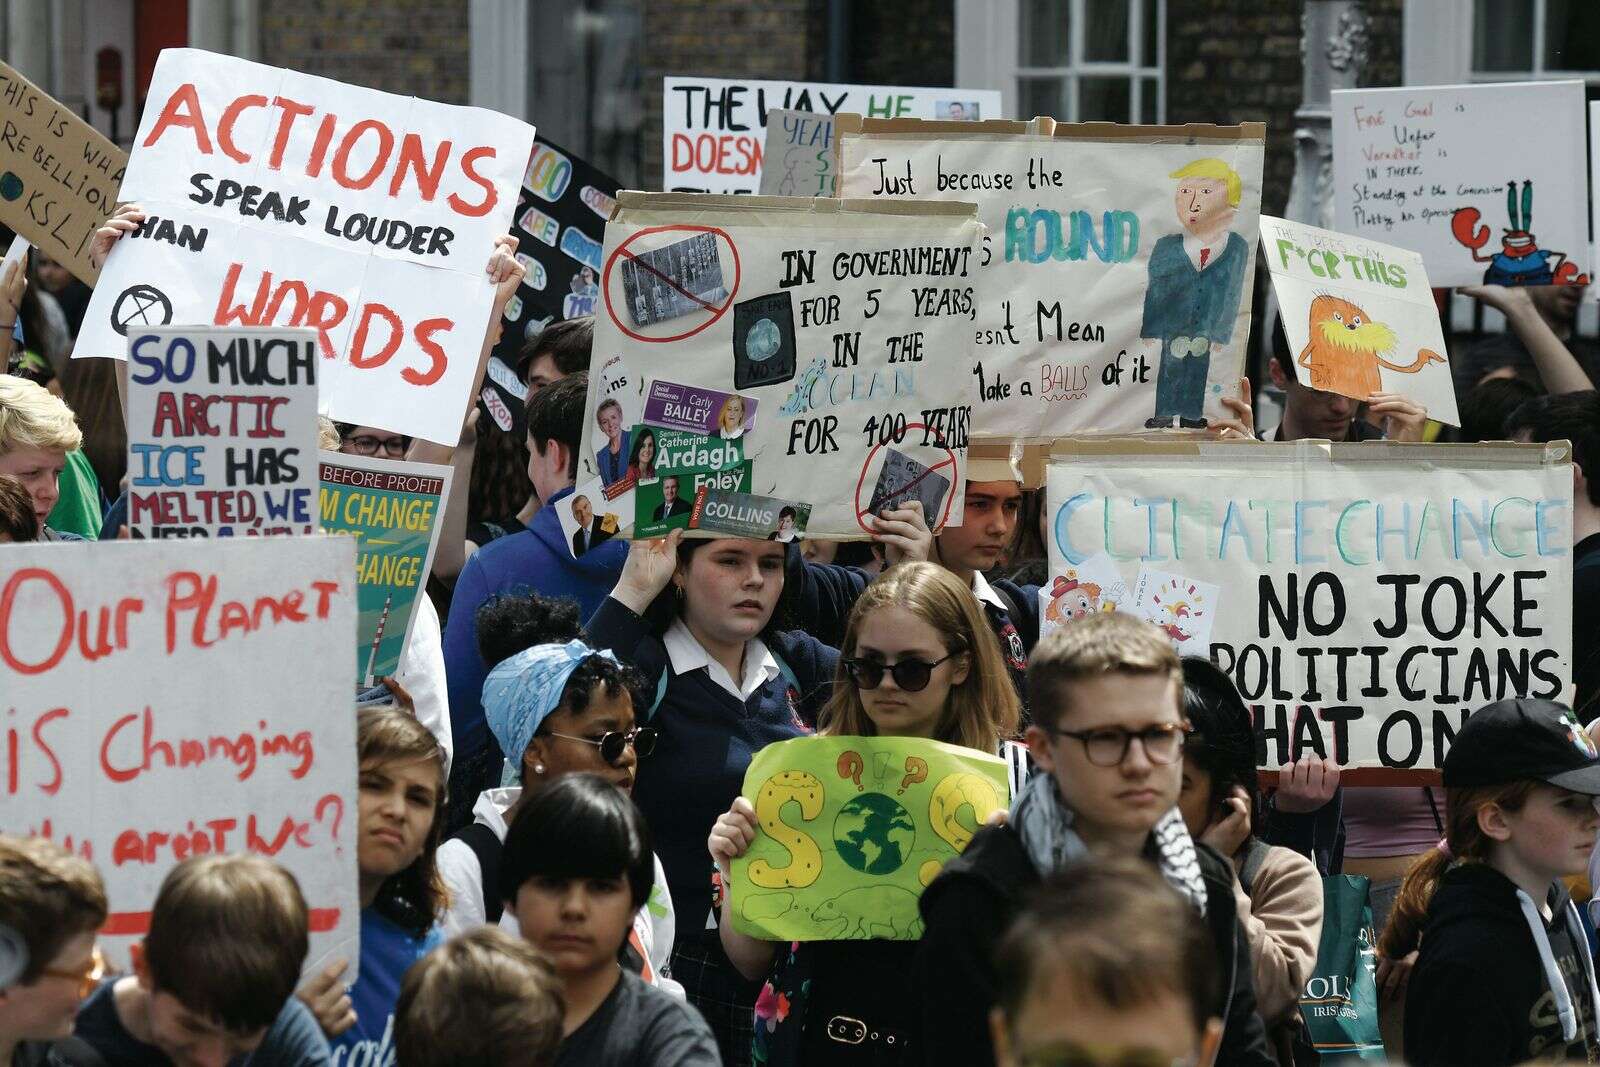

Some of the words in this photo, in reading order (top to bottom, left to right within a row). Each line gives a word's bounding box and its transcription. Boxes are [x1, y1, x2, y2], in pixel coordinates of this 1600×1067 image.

[672, 86, 750, 131] THE
[143, 84, 498, 216] ACTIONS
[872, 158, 917, 196] Just
[936, 155, 1013, 192] because
[1026, 157, 1063, 189] the
[122, 217, 208, 252] HAN
[189, 173, 310, 225] SPEAK
[325, 206, 455, 256] LOUDER
[1004, 208, 1140, 264] ROUND
[779, 250, 816, 288] IN
[832, 247, 972, 281] GOVERNMENT
[1343, 253, 1408, 289] THIS
[214, 263, 455, 386] WORDS
[801, 295, 840, 328] FOR
[864, 288, 883, 319] 5
[912, 287, 977, 321] YEARS,
[1037, 300, 1105, 343] Mean
[131, 335, 196, 385] SO
[207, 338, 315, 386] MUCH
[833, 332, 862, 368] IN
[886, 332, 924, 363] THE
[1020, 381, 1033, 396] a
[1041, 364, 1091, 394] BALLS
[1101, 350, 1127, 386] of
[1132, 354, 1151, 384] it
[152, 392, 290, 438] ARCTIC
[664, 402, 711, 423] BAILEY
[690, 394, 713, 411] Carly
[659, 435, 708, 448] Catherine
[787, 415, 839, 455] FOR
[863, 412, 906, 447] 400
[919, 405, 972, 449] YEARS
[131, 444, 205, 486] ICE
[226, 448, 300, 486] HAS
[654, 440, 739, 470] Ardagh
[323, 466, 381, 488] BEFORE
[387, 475, 441, 494] PROFIT
[695, 472, 744, 493] Foley
[131, 490, 263, 528] MELTED,
[264, 489, 311, 523] WE
[344, 493, 433, 531] CHANGE
[705, 501, 773, 526] COLLINS
[0, 567, 144, 675] Our
[1258, 571, 1347, 641] NO
[1373, 570, 1547, 641] JOKE
[1209, 643, 1563, 704] POLITICIANS
[100, 705, 313, 782] Changing
